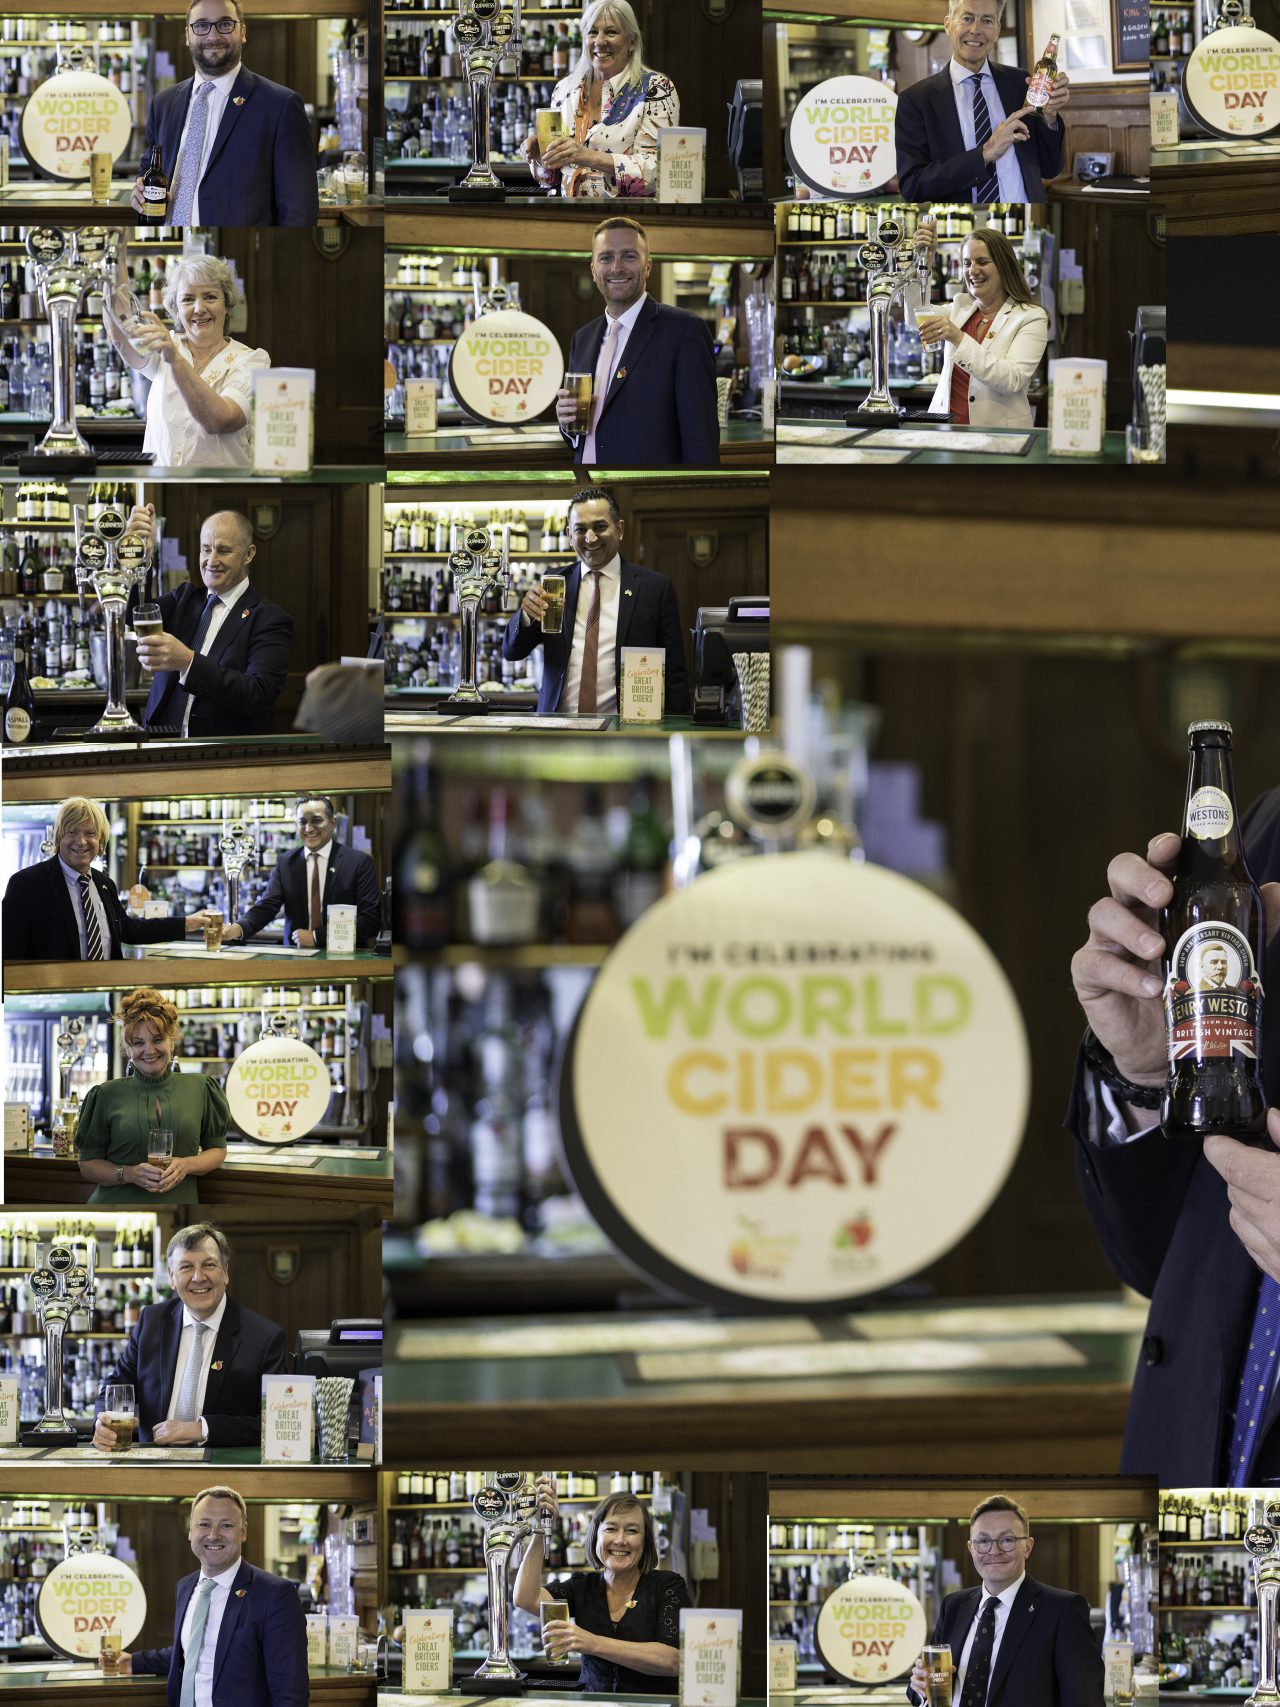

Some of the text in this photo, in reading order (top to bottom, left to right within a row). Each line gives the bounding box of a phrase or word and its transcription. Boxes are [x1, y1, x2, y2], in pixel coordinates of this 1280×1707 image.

[1209, 72, 1278, 91] CIDER
[37, 100, 118, 116] WORLD
[1224, 92, 1267, 109] DAY
[805, 106, 895, 124] WORLD
[43, 118, 110, 134] CIDER
[815, 126, 889, 144] CIDER
[56, 136, 99, 152] DAY
[829, 146, 877, 164] DAY
[672, 161, 691, 169] GREAT
[669, 171, 693, 179] BRITISH
[670, 180, 692, 189] CIDERS
[466, 340, 550, 357] WORLD
[475, 359, 543, 376] CIDER
[489, 378, 532, 395] DAY
[632, 686, 653, 694] BRITISH
[633, 695, 652, 703] CIDERS
[1189, 809, 1230, 822] WESTONS
[1183, 930, 1220, 953] ANNIVERSARY
[1221, 931, 1242, 949] VINTAGE
[667, 942, 935, 965] I'M CELEBRATING
[630, 974, 974, 1041] WORLD
[1176, 1028, 1254, 1038] BRITSH VINTAGE
[239, 1064, 318, 1082] WORLD
[245, 1083, 309, 1098] CIDER
[664, 1047, 944, 1118] CIDER
[256, 1101, 298, 1117] DAY
[721, 1123, 897, 1192] DAY
[278, 1411, 299, 1419] GREAT
[275, 1421, 301, 1430] BRITISH
[276, 1431, 300, 1441] CIDERS
[478, 1497, 503, 1507] Carlsberg
[52, 1581, 133, 1597] WORLD
[60, 1598, 126, 1615] CIDER
[832, 1605, 913, 1621] WORLD
[74, 1616, 116, 1632] DAY
[839, 1622, 906, 1639] CIDER
[417, 1643, 437, 1651] GREAT
[698, 1649, 723, 1659] GREAT
[851, 1641, 894, 1657] DAY
[415, 1652, 440, 1661] BRITISH
[416, 1662, 438, 1671] CIDERS
[695, 1661, 726, 1672] BRITISH
[696, 1673, 724, 1684] CIDERS
